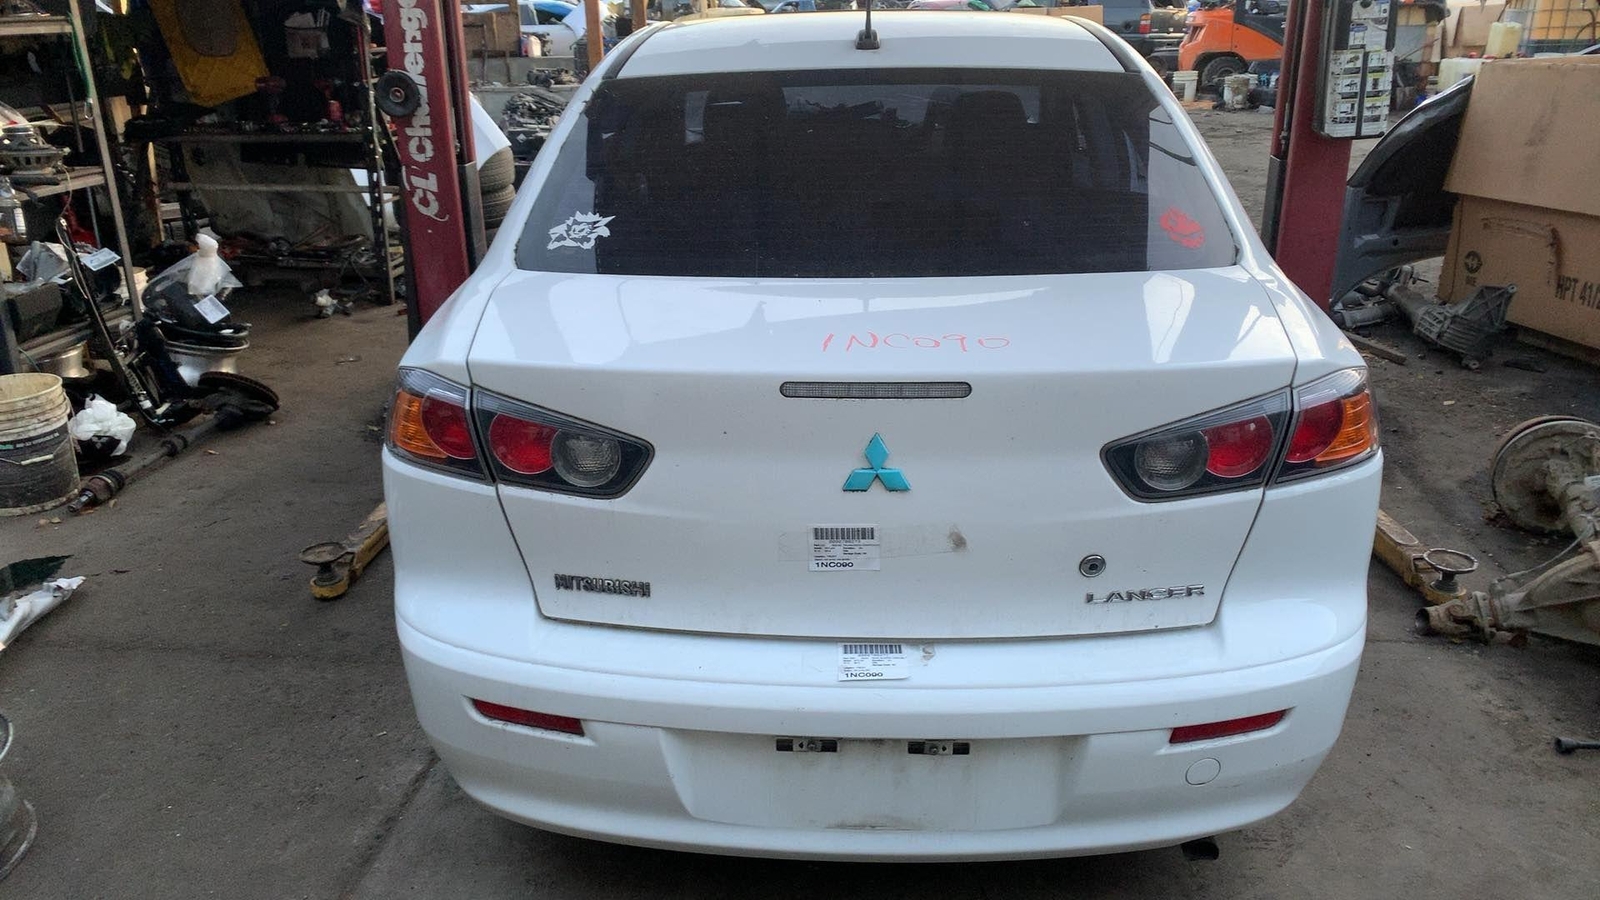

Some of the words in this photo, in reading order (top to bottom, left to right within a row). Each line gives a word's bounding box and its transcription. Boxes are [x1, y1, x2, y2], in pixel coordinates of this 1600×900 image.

[397, 0, 434, 163] Chleng
[554, 573, 651, 598] MITSUBISHI
[1085, 583, 1205, 604] LANCER
